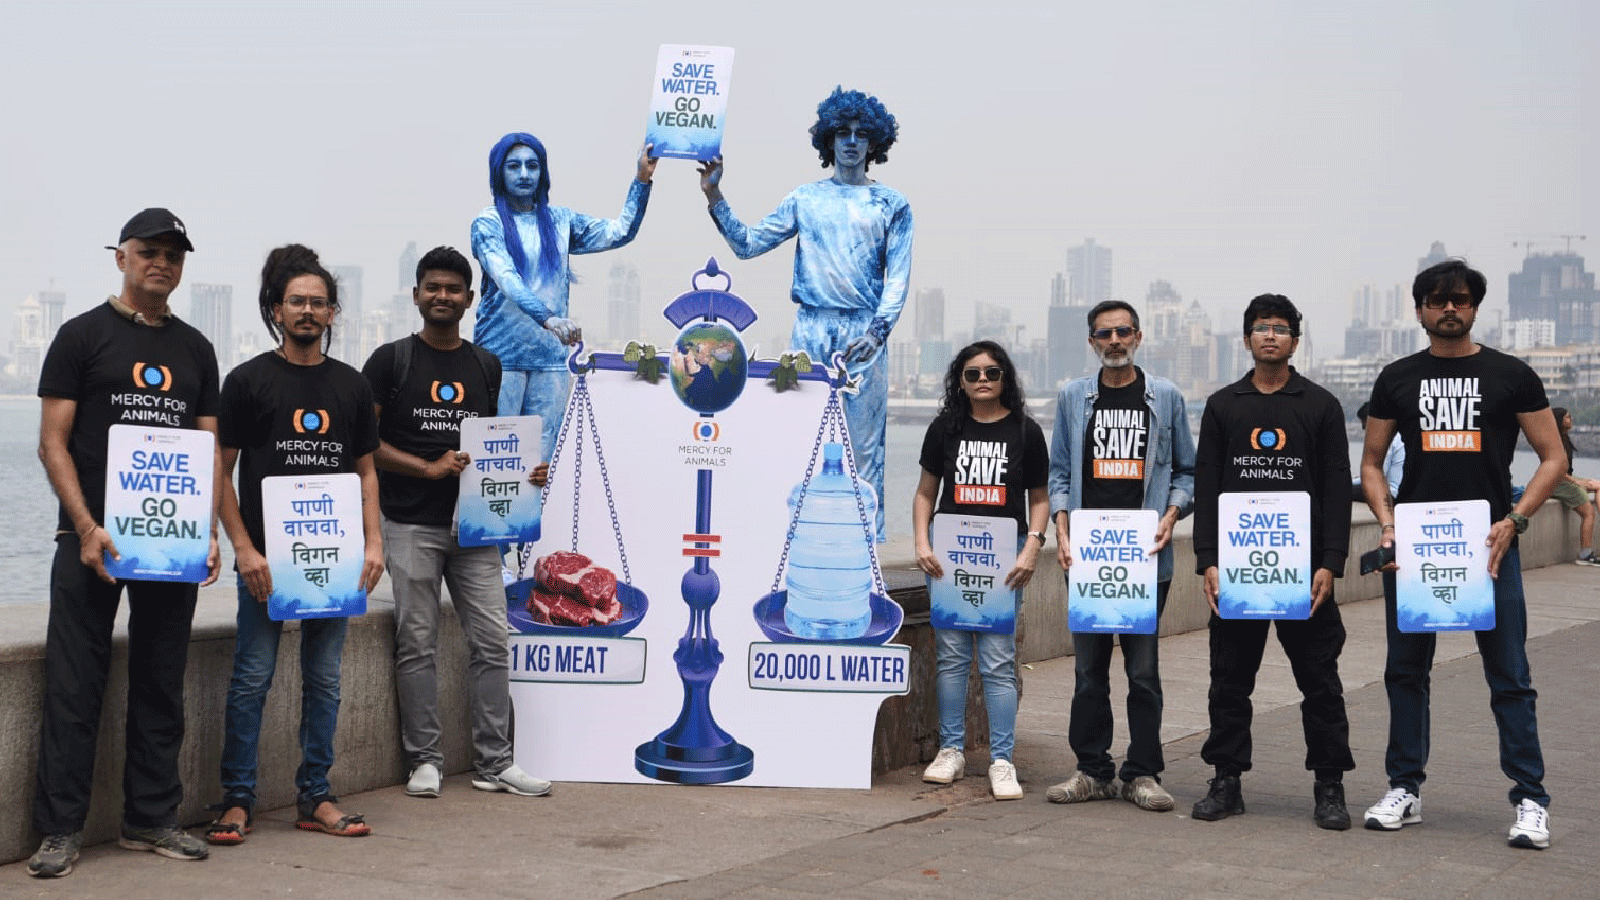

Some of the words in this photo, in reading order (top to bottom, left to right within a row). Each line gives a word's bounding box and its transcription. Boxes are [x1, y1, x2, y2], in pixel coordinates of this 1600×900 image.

[672, 63, 714, 78] SAVE
[662, 78, 719, 95] WATER.
[675, 97, 700, 112] GO
[656, 111, 716, 129] VEGAN.
[1420, 378, 1482, 398] ANIMAL
[111, 393, 161, 407] MERCY
[164, 398, 186, 414] FOR
[121, 409, 180, 427] ANIMALS
[413, 408, 453, 418] MERCY
[1095, 409, 1146, 429] ANIMAL
[1419, 397, 1481, 431] SAVE
[421, 422, 459, 432] ANIMA
[276, 441, 319, 451] MERCY
[321, 442, 342, 453] FOR
[484, 434, 519, 454] पाणी
[1093, 428, 1146, 460] SAVE
[1429, 432, 1475, 448] INDIA
[679, 446, 711, 454] MERCY
[713, 447, 732, 455] FOR
[958, 440, 1008, 460] ANIMAL
[132, 450, 189, 472] SAVE
[285, 455, 339, 467] ANIMALS
[475, 457, 526, 472] वाचवा,
[685, 457, 726, 466] ANIMALS
[1099, 461, 1138, 476] INDIA
[1234, 456, 1274, 466] MERCY
[1277, 457, 1302, 467] FOR
[955, 457, 1008, 485] SAVE
[1240, 469, 1294, 480] ANIMALS
[119, 471, 201, 496] WATER.
[481, 478, 520, 497] विगन
[960, 487, 1000, 503] INDIA
[142, 497, 176, 518] GO
[291, 494, 333, 516] पाणी
[489, 500, 512, 517] व्हा
[114, 516, 202, 539] VEGAN.
[283, 519, 345, 537] वाचवा,
[1239, 513, 1289, 529] SAVE
[1421, 518, 1463, 539] पाणी
[957, 532, 993, 550] पाणी
[1090, 529, 1138, 545] SAVE
[1228, 531, 1299, 547] WATER.
[292, 542, 339, 565] विगन
[1080, 547, 1148, 562] WATER.
[1249, 550, 1279, 567] GO
[1413, 541, 1473, 558] वाचवा,
[948, 550, 1000, 570] वाचवा,
[304, 567, 330, 587] व्हा
[954, 569, 994, 588] विगन
[1098, 566, 1128, 582] GO
[1226, 568, 1303, 584] VEGAN.
[1420, 563, 1467, 583] विगन
[962, 589, 986, 607] व्हा
[1077, 582, 1150, 599] VEGAN.
[1432, 585, 1457, 604] व्हा
[512, 644, 518, 671] 1
[525, 644, 550, 672] KG
[555, 645, 608, 673] MEAT
[754, 652, 820, 682] 20,000
[827, 655, 836, 681] L
[841, 655, 904, 683] WATER
